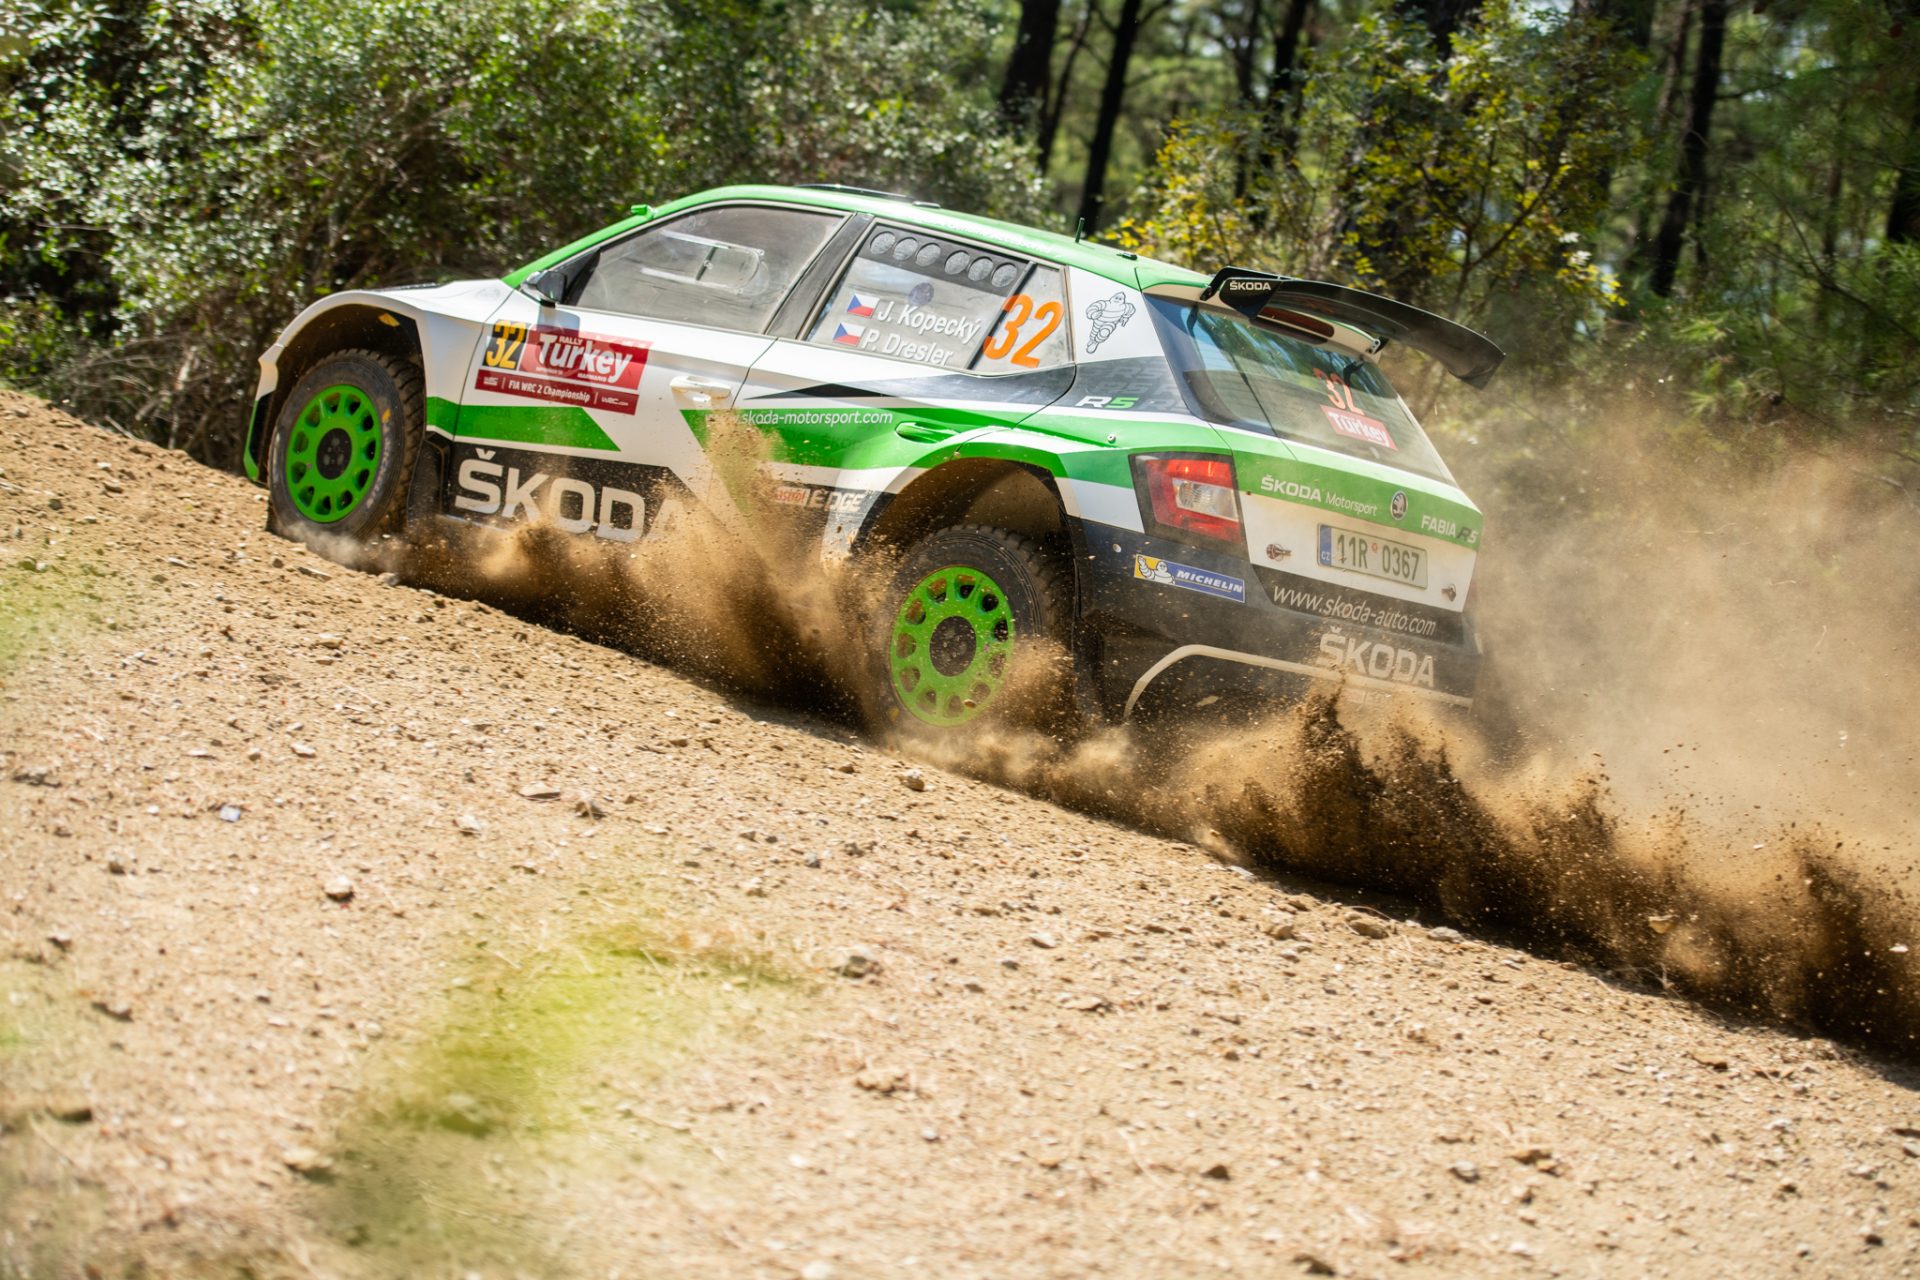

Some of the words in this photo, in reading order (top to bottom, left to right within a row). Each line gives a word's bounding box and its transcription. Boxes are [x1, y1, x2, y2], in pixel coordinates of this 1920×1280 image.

[1229, 281, 1271, 291] ŠKODA
[485, 319, 526, 369] 32
[558, 335, 583, 345] RALLY
[877, 301, 895, 322] J.
[897, 304, 983, 344] Kopecký
[982, 294, 1065, 369] 32
[539, 333, 632, 383] Turkey
[861, 329, 880, 349] P.
[883, 332, 953, 366] Dresler
[508, 380, 521, 391] FIA
[521, 382, 537, 394] WRC
[537, 384, 544, 395] 2
[544, 385, 590, 403] Championship
[1075, 395, 1139, 409] R5
[1313, 368, 1365, 416] 32
[1261, 474, 1321, 502] ŠKODA
[1326, 492, 1378, 517] Motorsport
[1421, 514, 1457, 538] FABIA
[1321, 551, 1331, 561] CZ
[1338, 534, 1368, 569] 11R
[1382, 541, 1420, 581] 0367
[1176, 570, 1243, 593] MICHELIN
[1273, 585, 1437, 636] www.skoda-auto.com
[1316, 625, 1434, 688] ŠKODA
